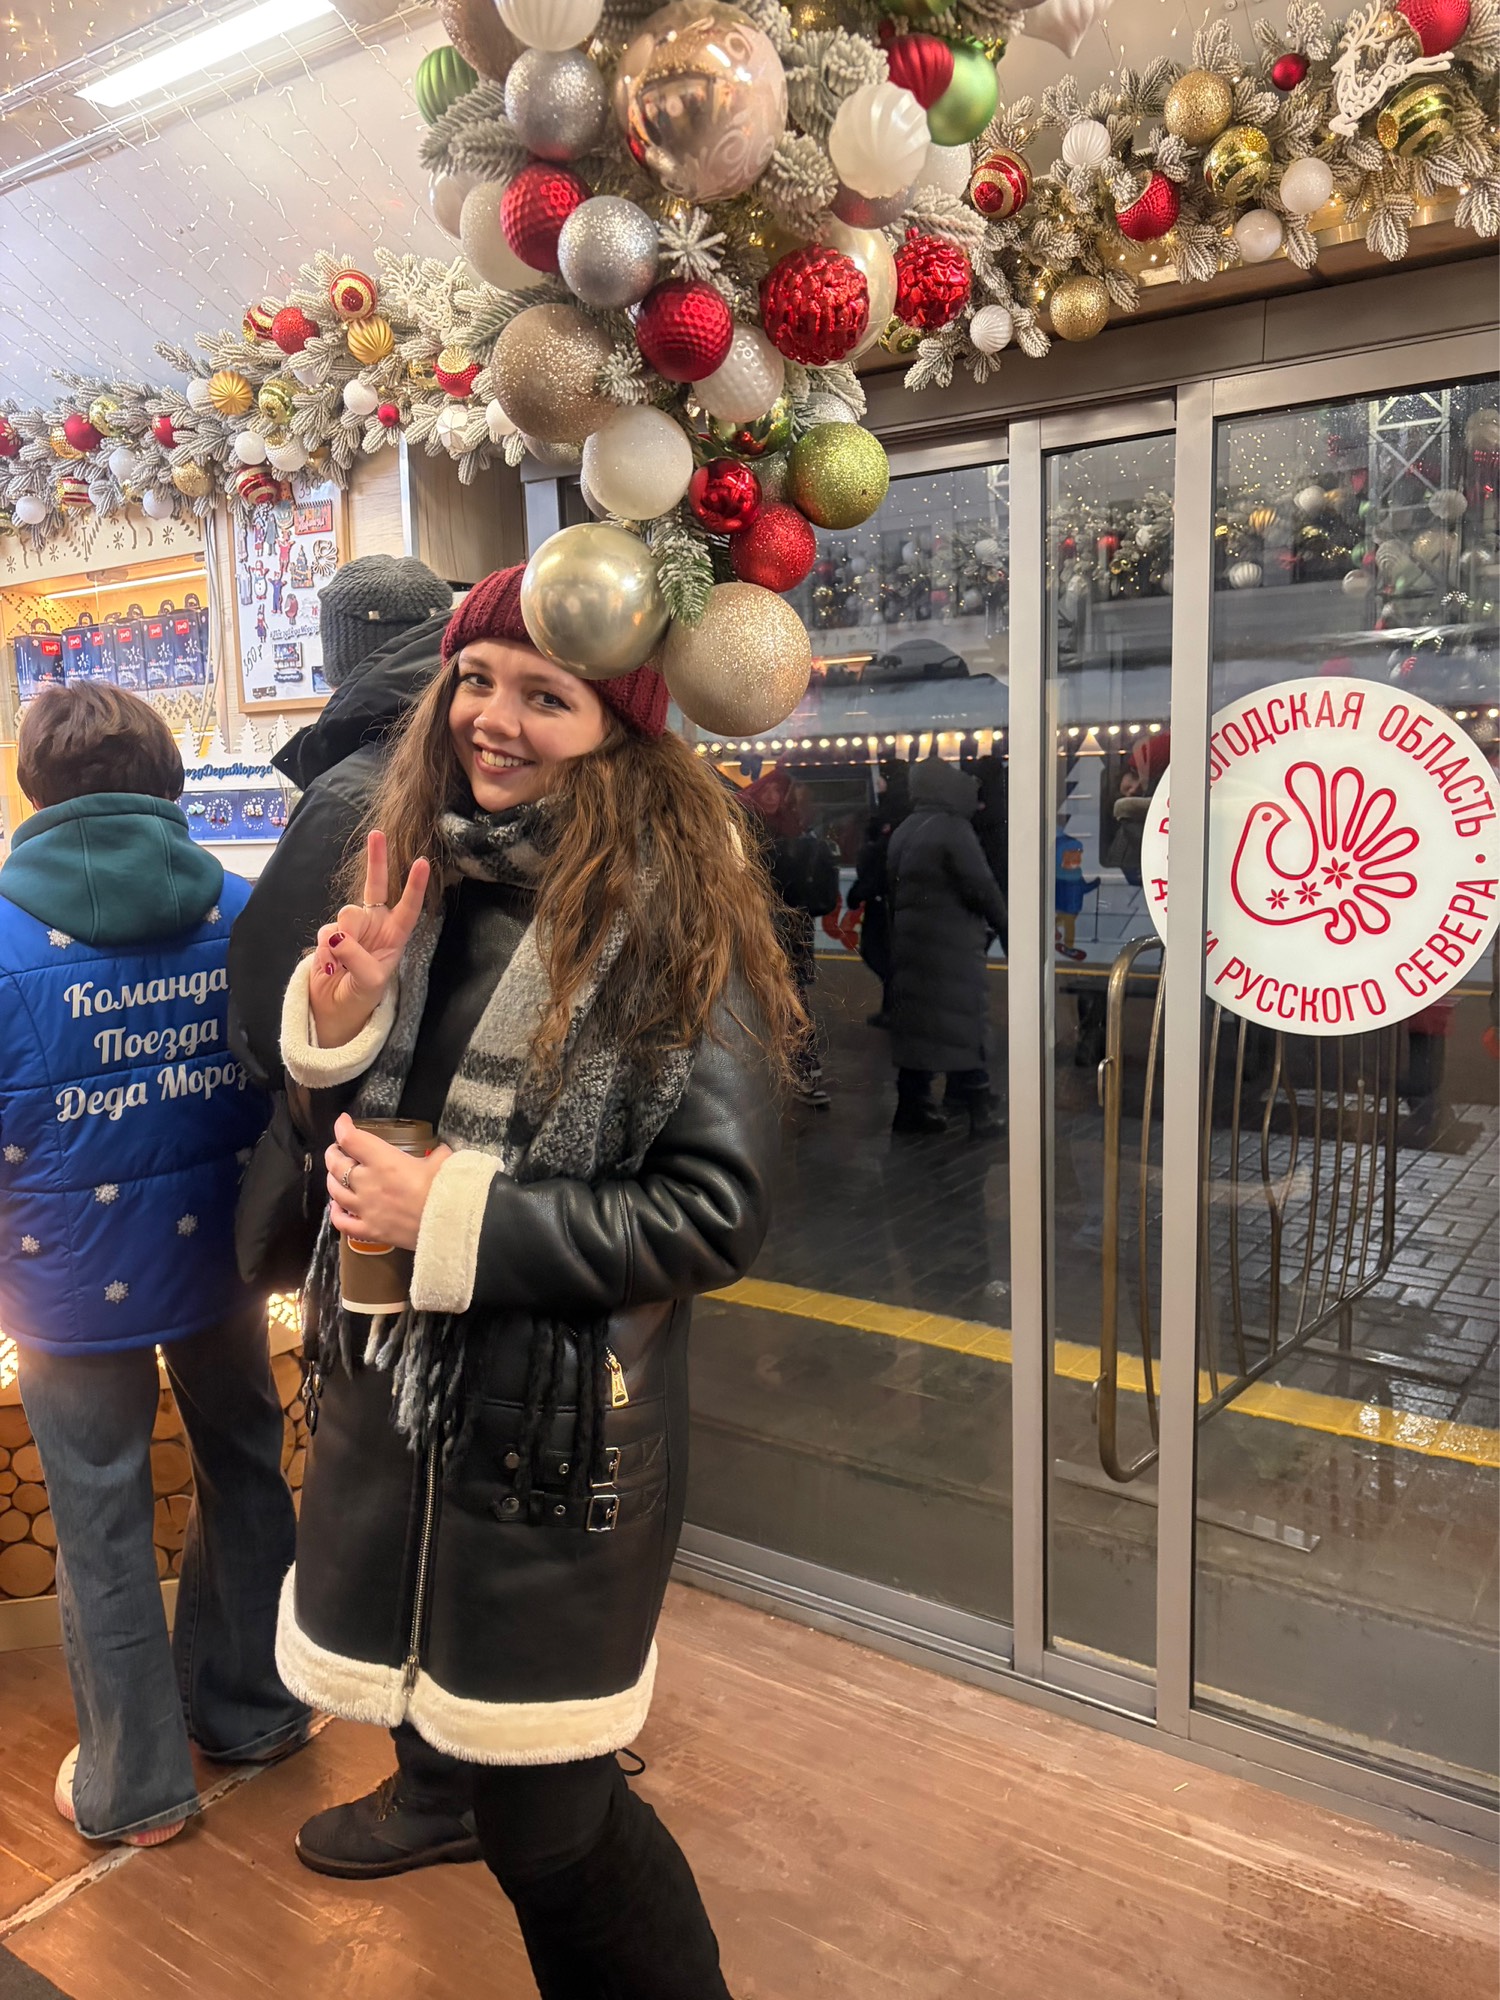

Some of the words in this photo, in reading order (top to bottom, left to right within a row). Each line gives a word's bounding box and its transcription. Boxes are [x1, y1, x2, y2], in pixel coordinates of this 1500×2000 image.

[184, 762, 274, 782] ездДедаМороза
[1210, 690, 1366, 782] ГОДСКАЯ
[1378, 704, 1497, 838] ОБЛАСТЬ
[1213, 956, 1387, 1024] РУССКОГО
[1394, 878, 1500, 998] СЕВЕРА
[63, 967, 229, 1019] Команда
[93, 1017, 220, 1066] Поезда
[55, 1083, 149, 1123] Деда
[157, 1061, 252, 1101] Мороз
